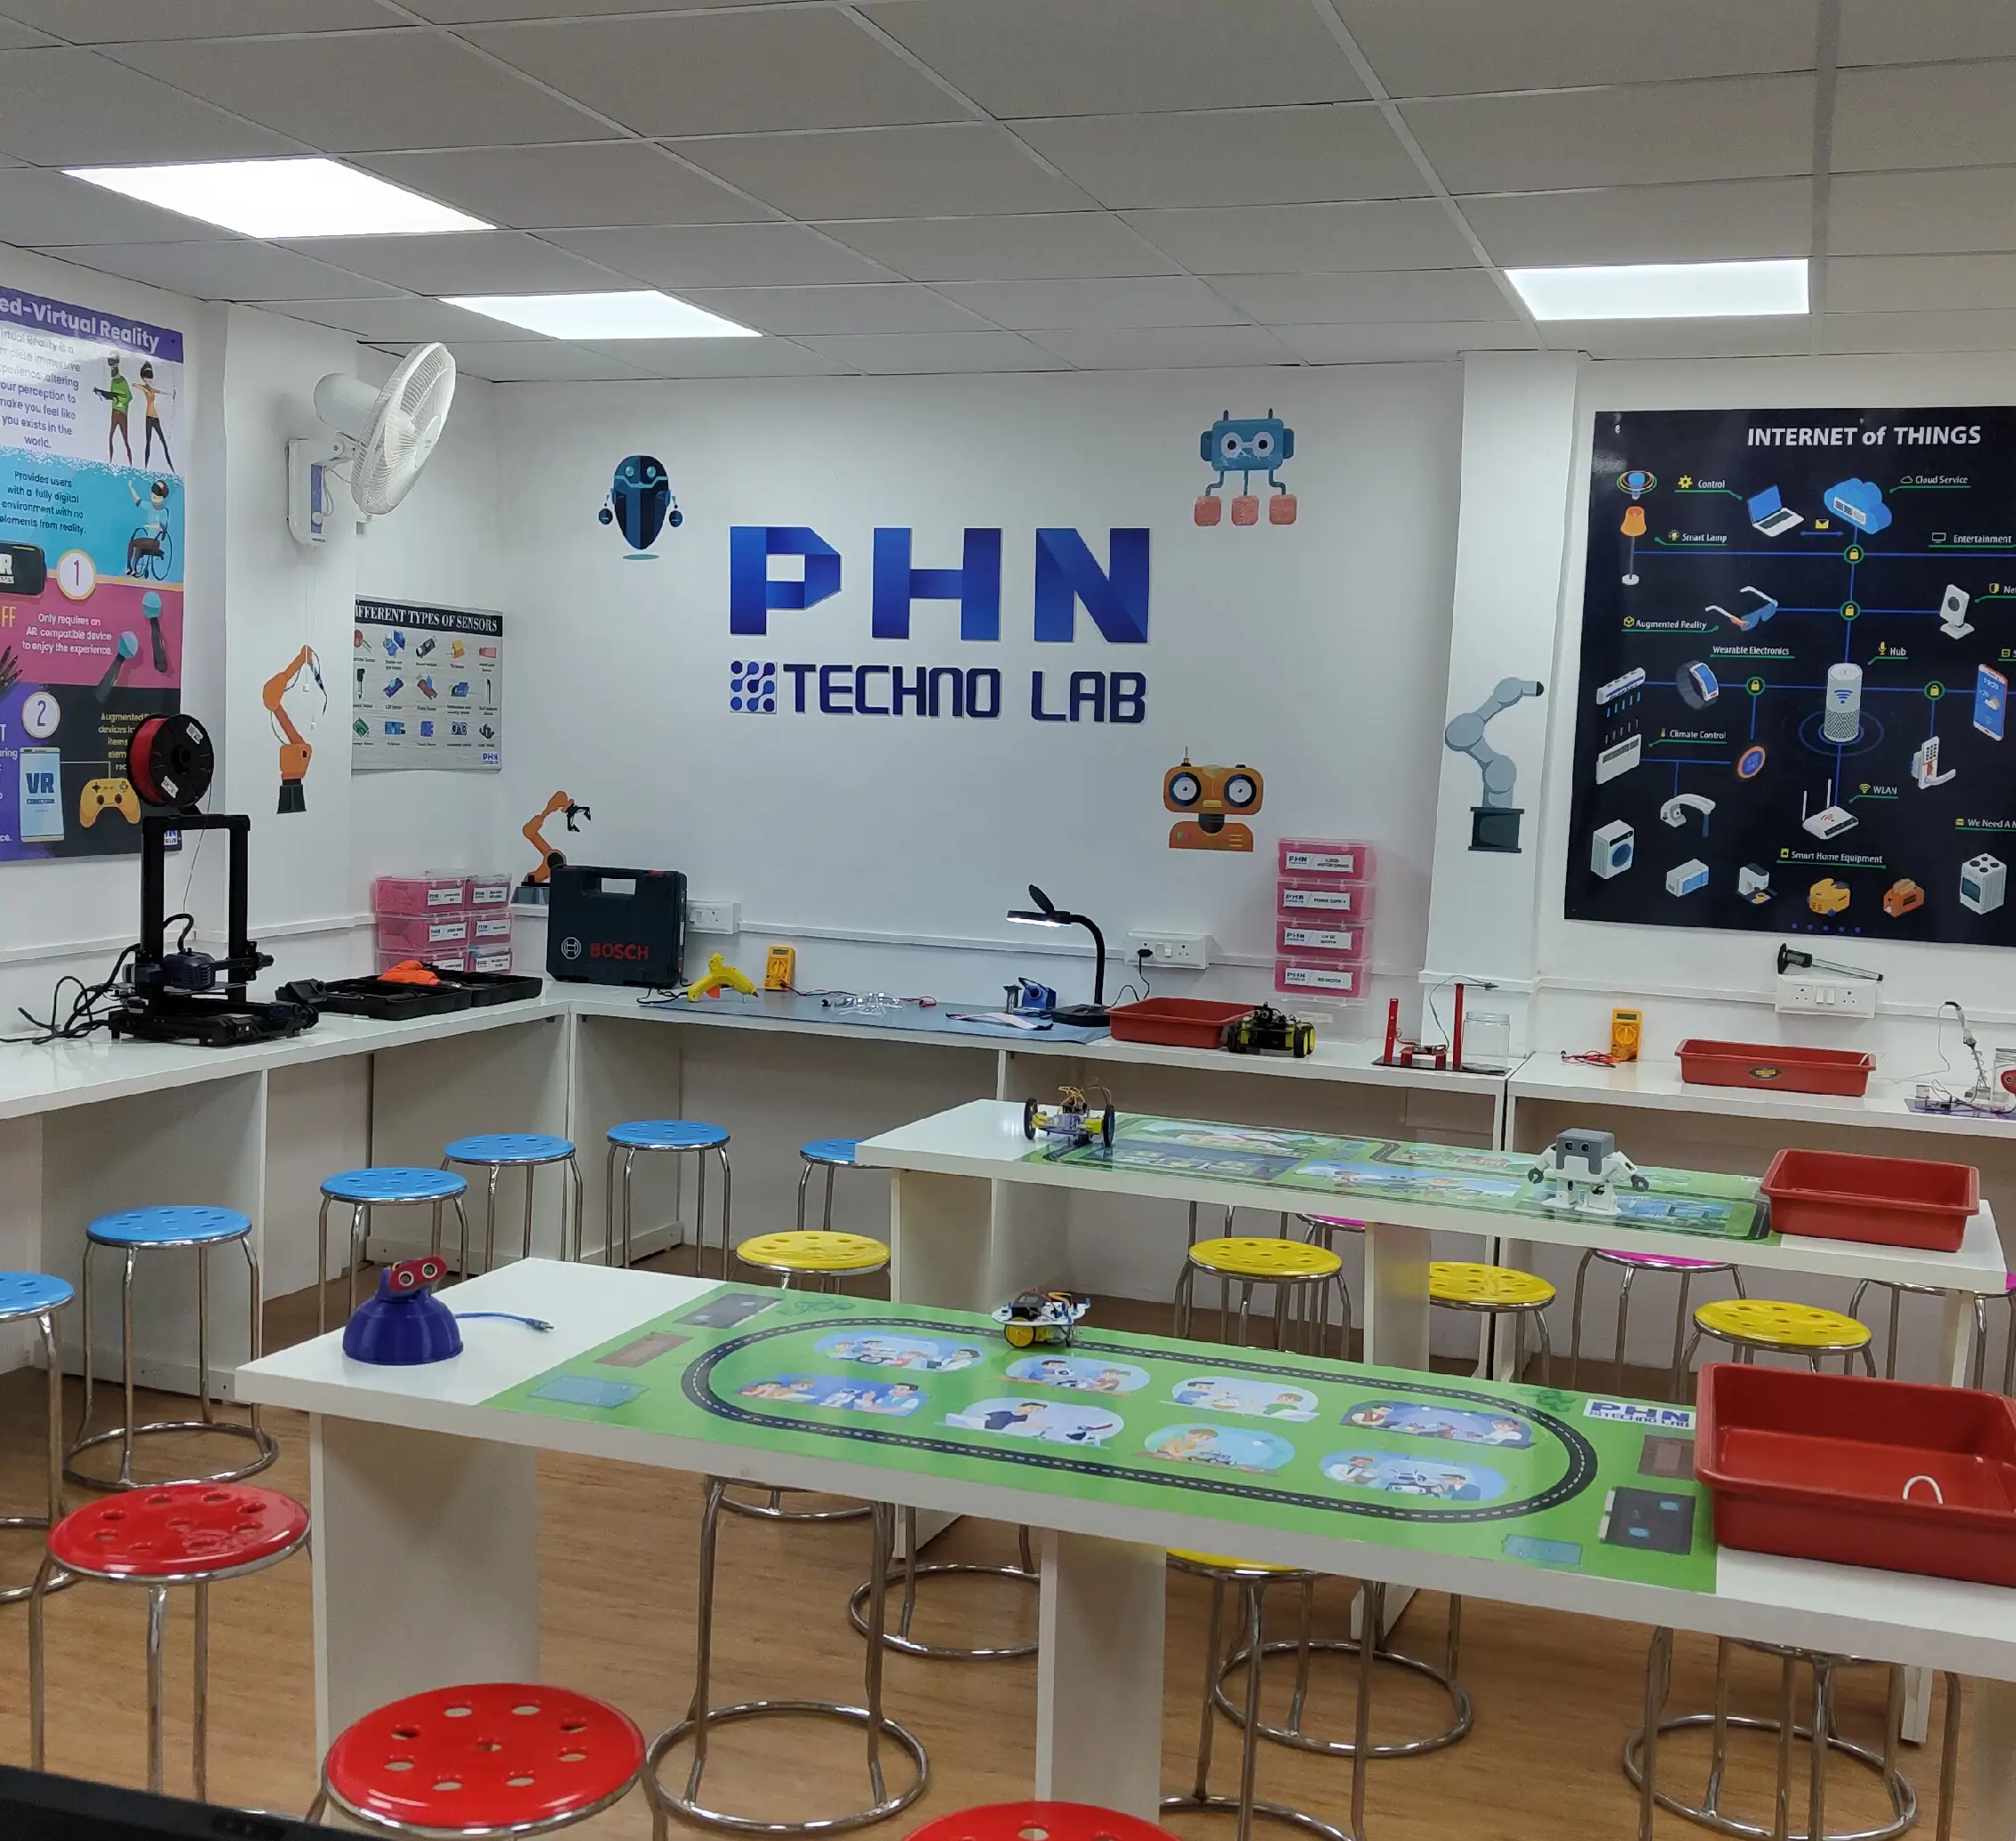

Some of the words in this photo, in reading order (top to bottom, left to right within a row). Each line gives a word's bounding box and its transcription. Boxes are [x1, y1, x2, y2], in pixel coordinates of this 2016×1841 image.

[27, 334, 57, 353] Reality
[101, 320, 159, 354] Reality
[18, 384, 65, 401] perception
[68, 393, 76, 403] to
[25, 403, 41, 414] you
[43, 404, 59, 417] feel
[61, 408, 76, 420] like
[2, 415, 19, 427] you
[21, 419, 46, 431] exists
[48, 423, 56, 433] in
[58, 424, 72, 436] the
[24, 436, 52, 448] world.
[1747, 428, 1857, 446] INTERNET
[1862, 426, 1886, 445] of
[1894, 426, 1982, 444] THINGS
[14, 471, 49, 485] Provides
[51, 478, 72, 487] users
[1698, 479, 1726, 489] Control
[1915, 475, 1938, 485] Cloud
[1939, 475, 1968, 485] Service
[7, 486, 25, 495] with
[36, 488, 53, 501] fully
[54, 493, 79, 505] digital
[2, 501, 54, 515] environment
[55, 507, 72, 517] with
[74, 511, 84, 519] no
[0, 514, 38, 528] elements
[40, 519, 58, 531] from
[1682, 534, 1704, 543] Smart
[1706, 533, 1727, 545] Lamp
[1953, 534, 2012, 544] Entertainment
[74, 559, 80, 586] 1
[729, 525, 1151, 643] PHN
[38, 613, 56, 625] Only
[58, 615, 89, 626] requires
[91, 618, 101, 626] an
[408, 610, 440, 625] TYPES
[442, 614, 455, 627] OF
[456, 615, 498, 632] SENSORS
[1636, 619, 1679, 631] Augmented
[1680, 619, 1708, 631] Reality
[26, 626, 37, 636] AR
[40, 629, 85, 639] compatible
[86, 631, 112, 641] device
[22, 640, 30, 650] to
[32, 641, 54, 655] enjoy
[55, 641, 68, 652] the
[1712, 646, 1748, 655] Wearable
[1749, 646, 1790, 656] Electronics
[1889, 647, 1906, 656] Hub
[783, 664, 1002, 720] TECHNO
[1031, 671, 1147, 724] LAB
[37, 700, 46, 727] 2
[101, 713, 143, 722] Augmented
[99, 725, 127, 734] devices
[1669, 729, 1700, 739] Climate
[1701, 729, 1726, 740] Control
[26, 772, 54, 794] VR
[1873, 786, 1898, 795] WLAN
[1967, 819, 1980, 827] We
[1982, 819, 2004, 828] Need
[2004, 820, 2011, 828] A
[1792, 851, 1815, 860] Smart
[1816, 851, 1839, 862] Home
[1840, 853, 1883, 865] Equipment
[589, 942, 649, 961] BOSCH
[1590, 1402, 1690, 1422] PHN
